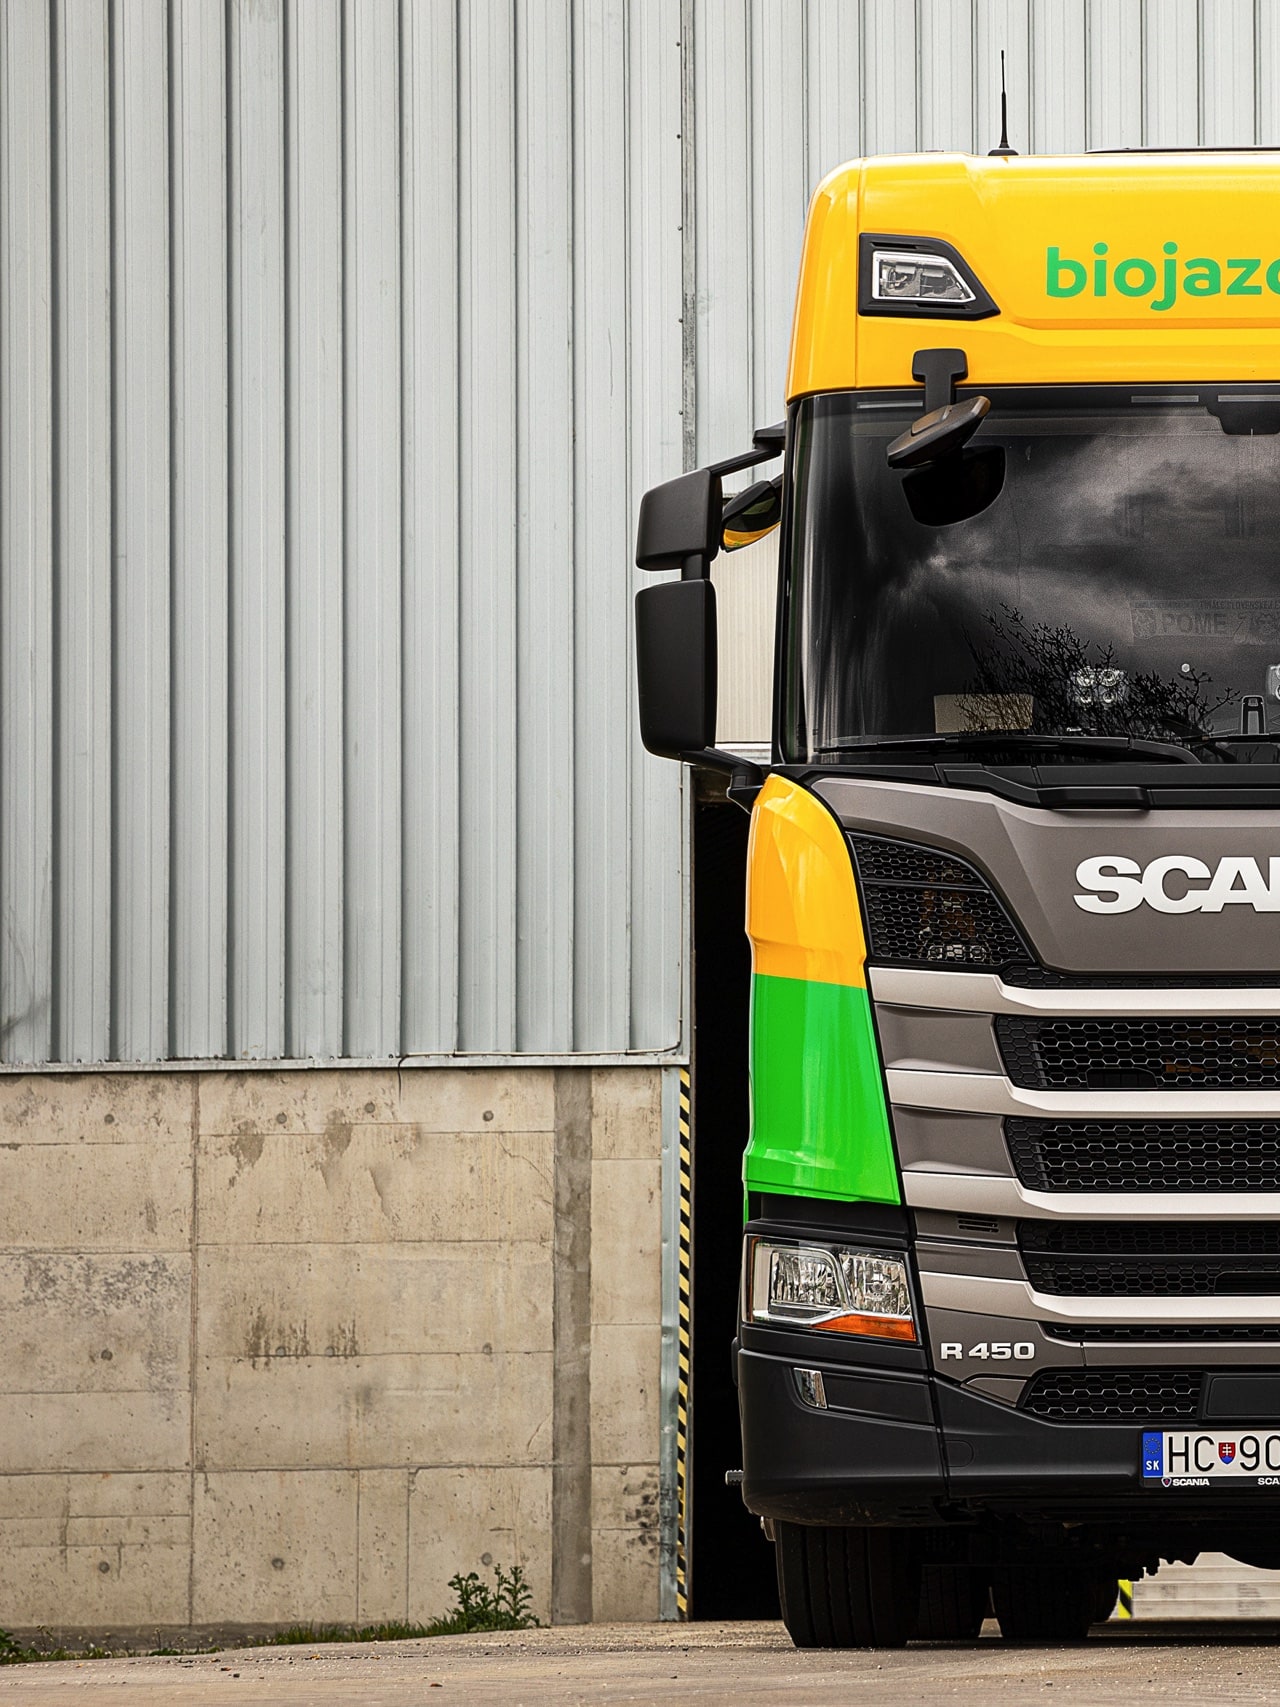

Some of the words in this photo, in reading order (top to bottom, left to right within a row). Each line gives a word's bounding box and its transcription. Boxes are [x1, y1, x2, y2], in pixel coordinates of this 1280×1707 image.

[1161, 613, 1228, 634] POME
[940, 1342, 963, 1360] R
[968, 1342, 1035, 1360] 450
[1167, 1435, 1215, 1473] HC
[1145, 1460, 1160, 1471] SK
[1172, 1477, 1210, 1487] SCANIA
